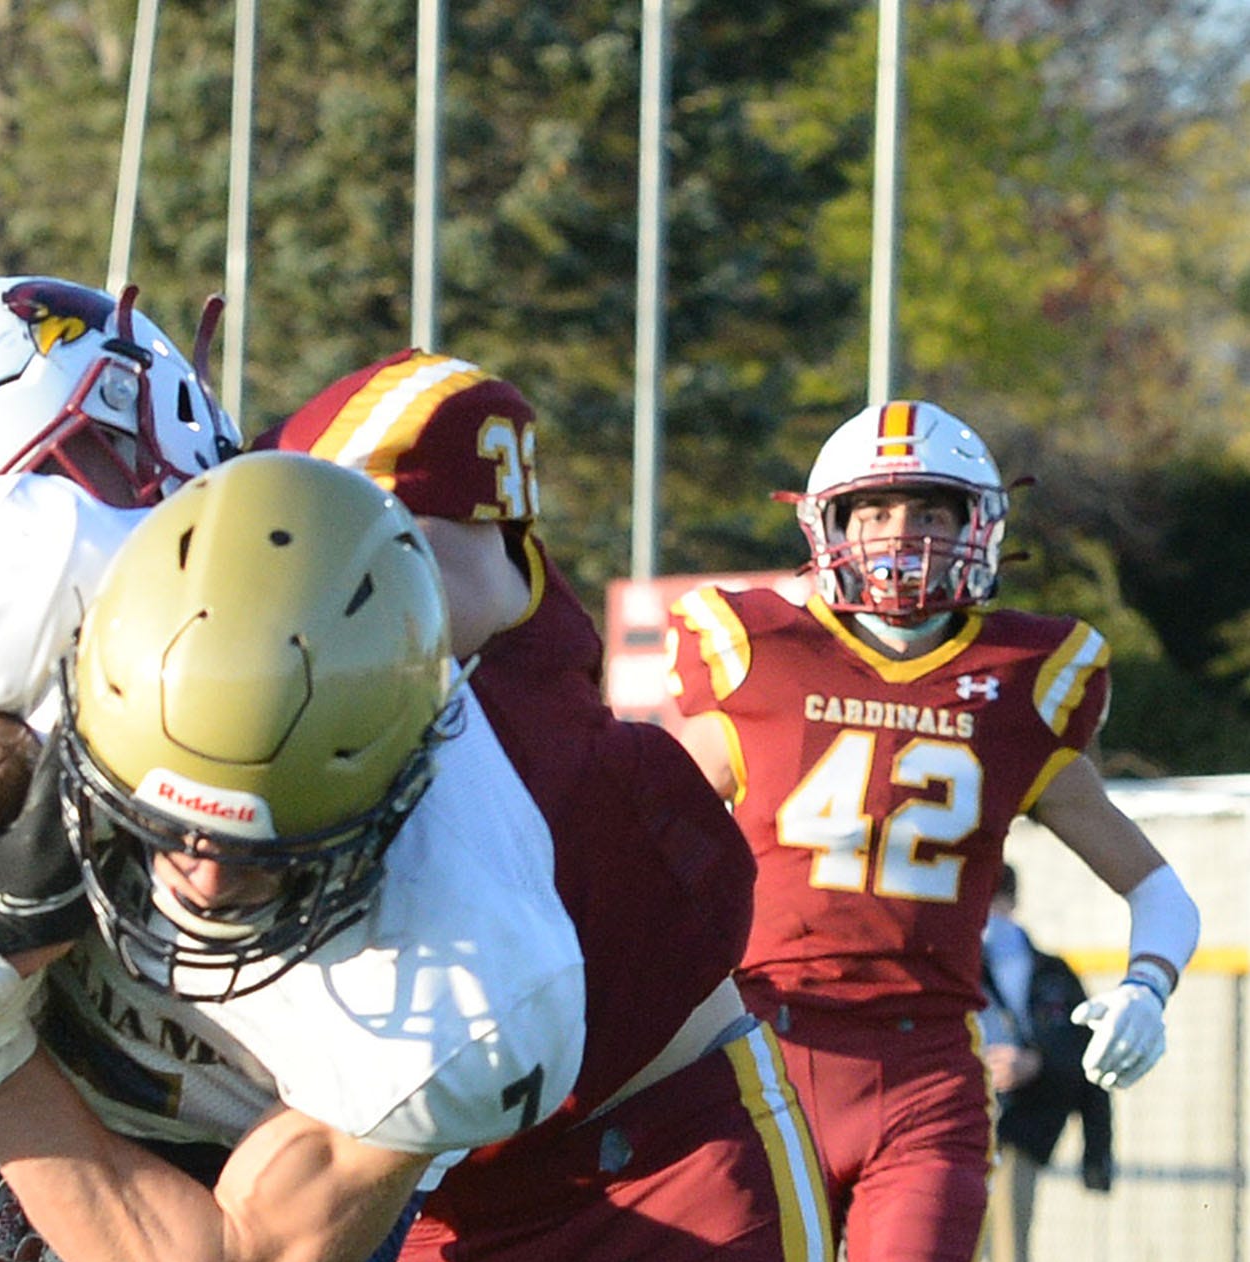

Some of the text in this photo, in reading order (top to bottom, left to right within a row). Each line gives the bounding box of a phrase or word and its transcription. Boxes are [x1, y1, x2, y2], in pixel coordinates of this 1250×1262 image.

[804, 693, 975, 739] CARDINALS
[157, 782, 256, 823] Riddell
[776, 727, 985, 903] 42
[500, 1062, 545, 1131] 7
